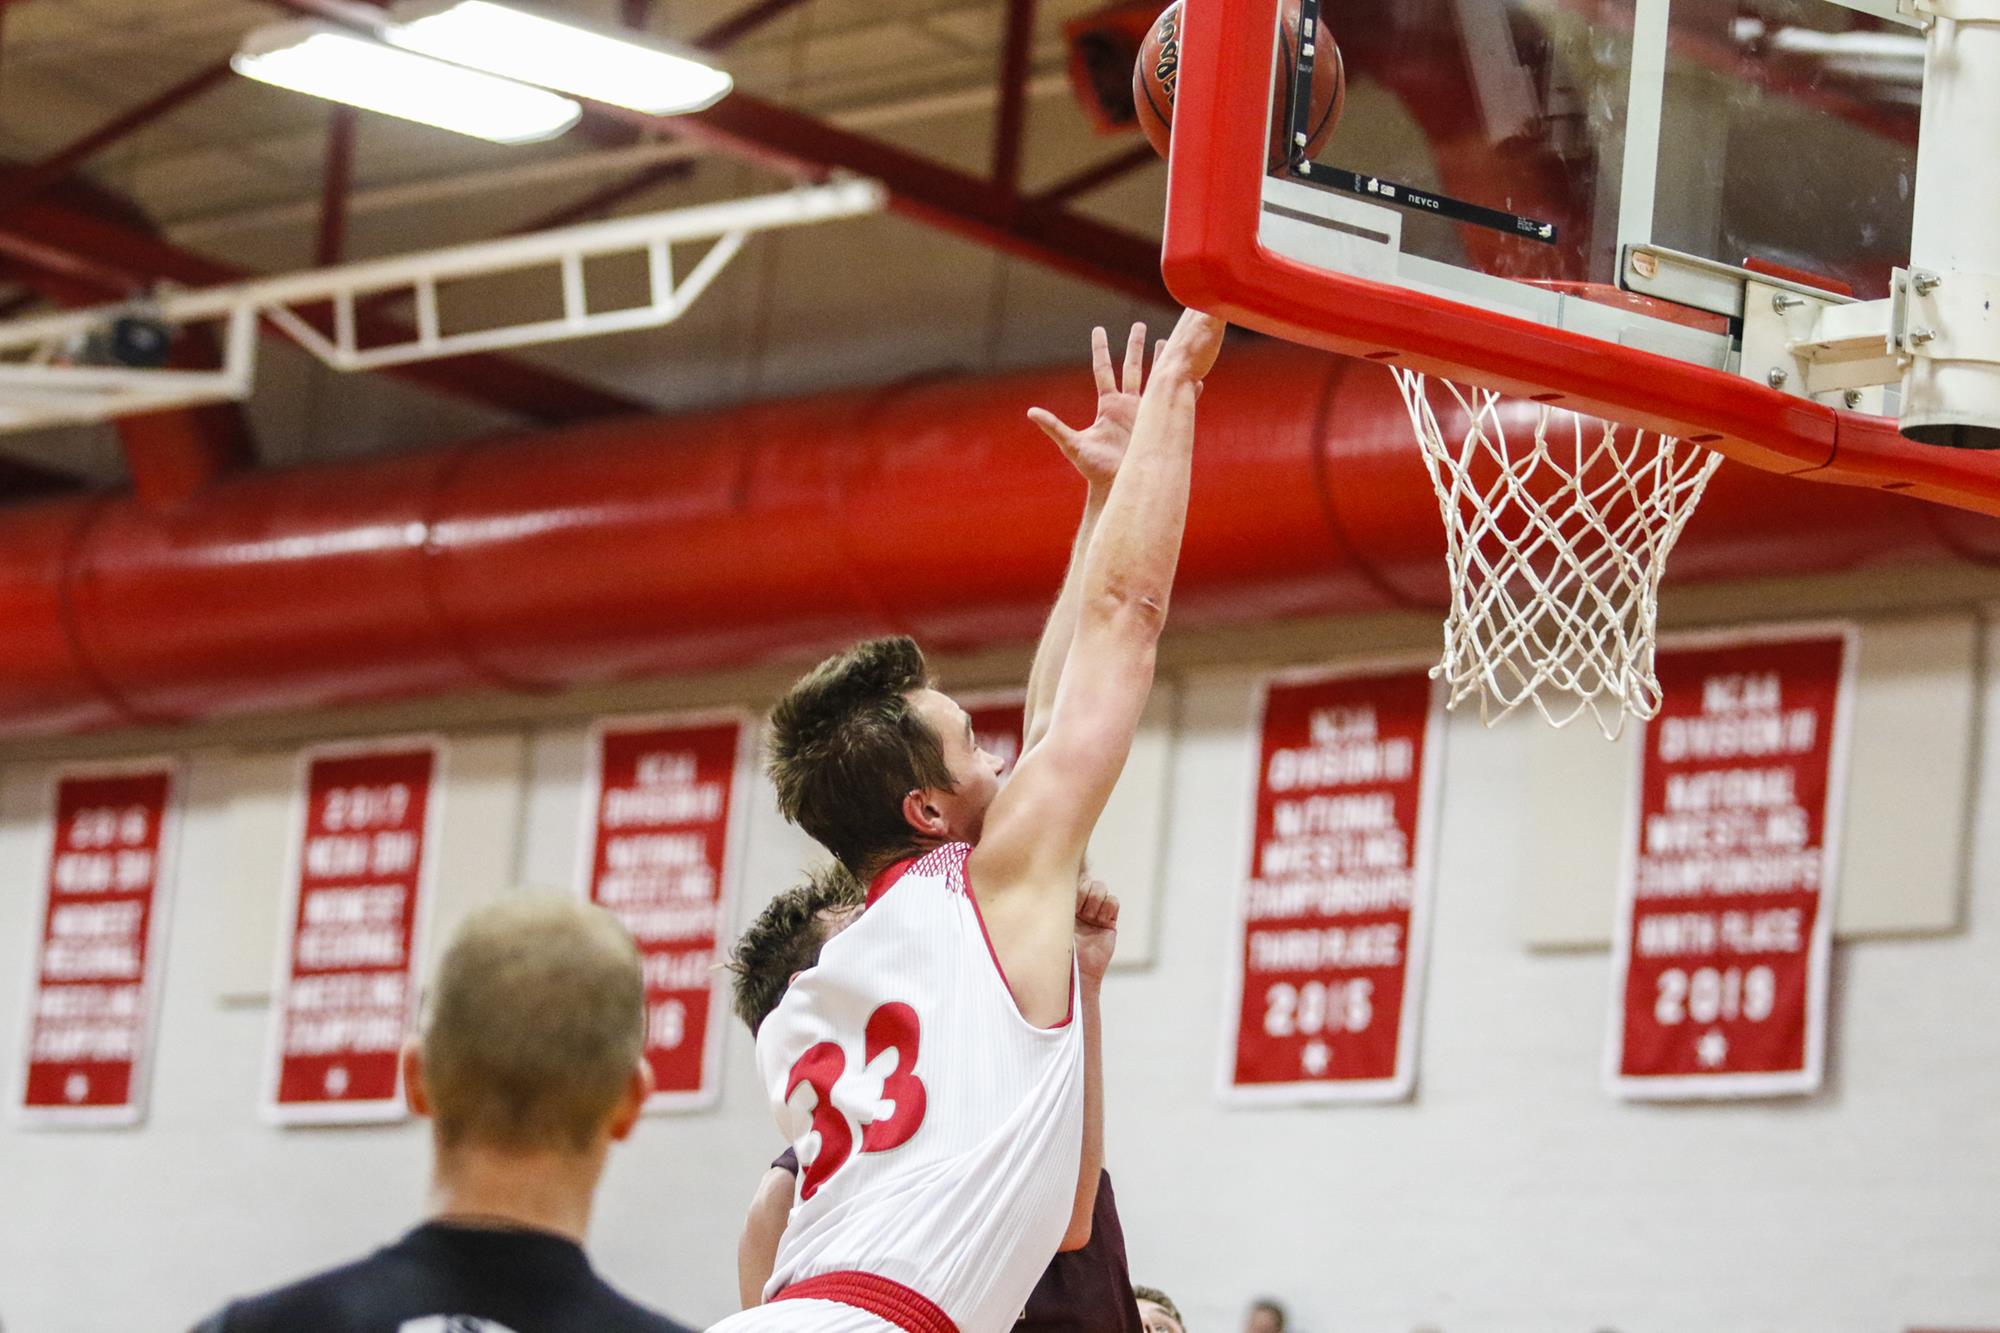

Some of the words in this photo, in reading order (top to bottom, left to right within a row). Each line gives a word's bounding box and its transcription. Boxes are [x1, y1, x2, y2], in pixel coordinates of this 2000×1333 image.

[1704, 675, 1781, 711] NCAA
[1310, 706, 1377, 743] NCAA
[1658, 712, 1782, 763] DIVISION
[1267, 742, 1382, 790] DIVISION
[1665, 766, 1795, 810] NATIONAL
[322, 783, 410, 832] 2017
[1274, 792, 1395, 835] NATIONAL
[1647, 806, 1808, 853] WRESTLING
[1261, 830, 1407, 875] WRESTLING
[1249, 929, 1320, 971] THIRD
[1321, 923, 1402, 969] PLACE
[1638, 911, 1715, 955] NINTH
[1720, 907, 1800, 954] PLACE
[1264, 977, 1374, 1037] 2015
[1654, 965, 1775, 1026] 2019
[785, 1001, 927, 1201] 33
